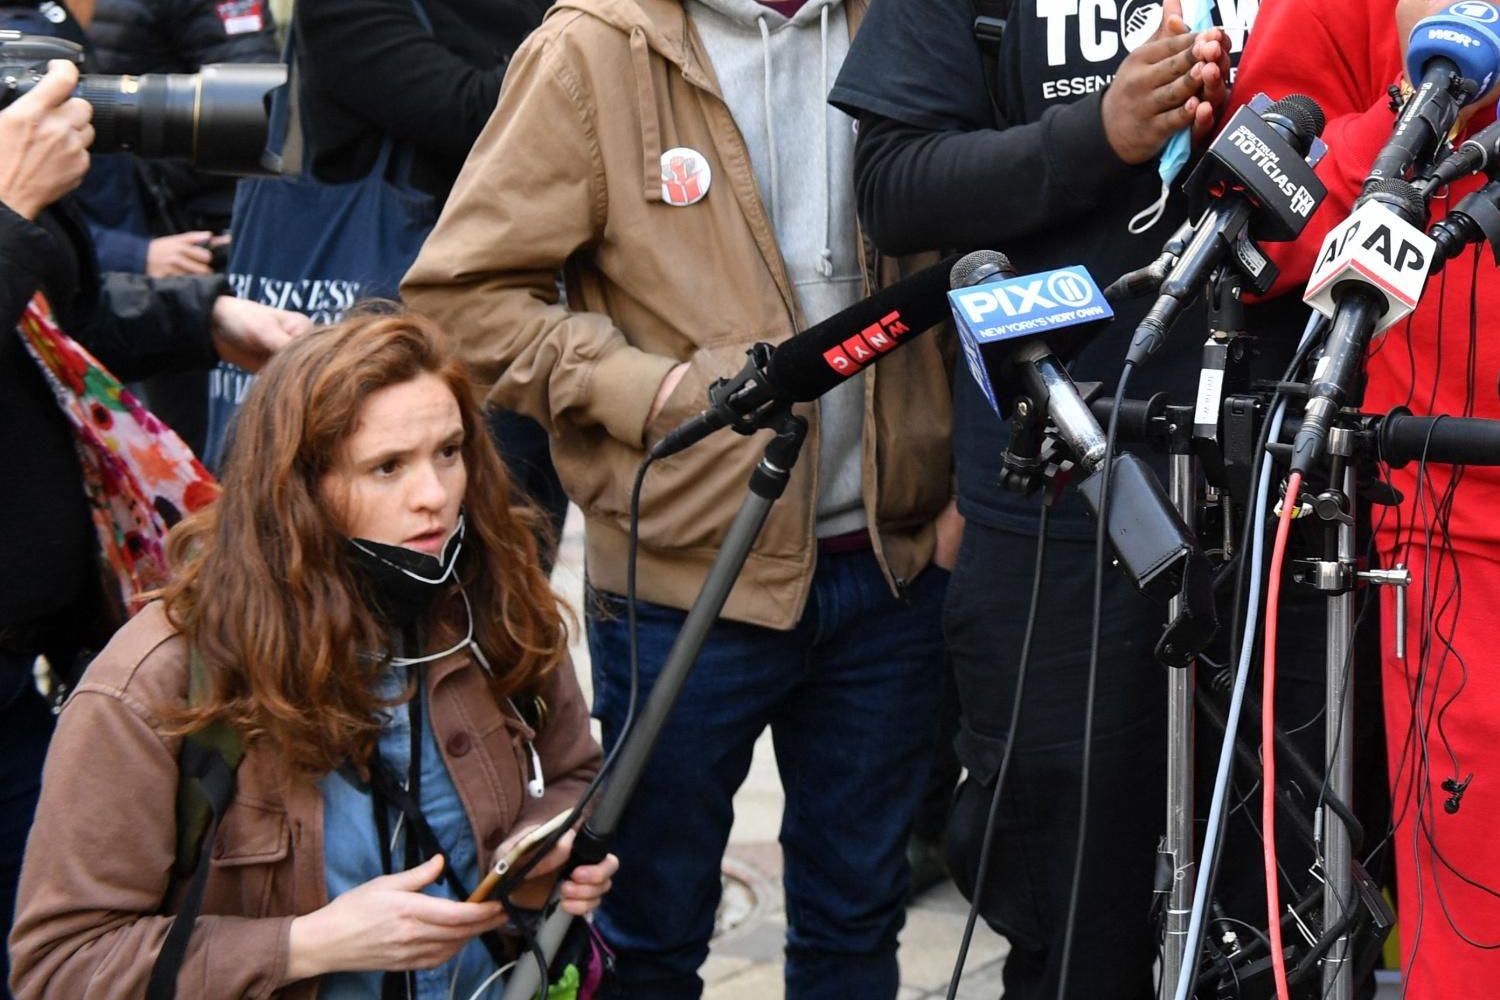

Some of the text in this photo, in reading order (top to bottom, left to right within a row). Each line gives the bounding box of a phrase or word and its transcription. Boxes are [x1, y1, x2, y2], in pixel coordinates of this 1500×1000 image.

[1042, 74, 1116, 99] ESSEN
[1237, 125, 1280, 163] SPECTRUM
[1316, 220, 1361, 274] AP
[1361, 224, 1425, 272] AP
[959, 279, 1058, 324] PIX
[979, 305, 1105, 338] NEW YORK'S VERY OWN
[832, 320, 911, 370] WNYC
